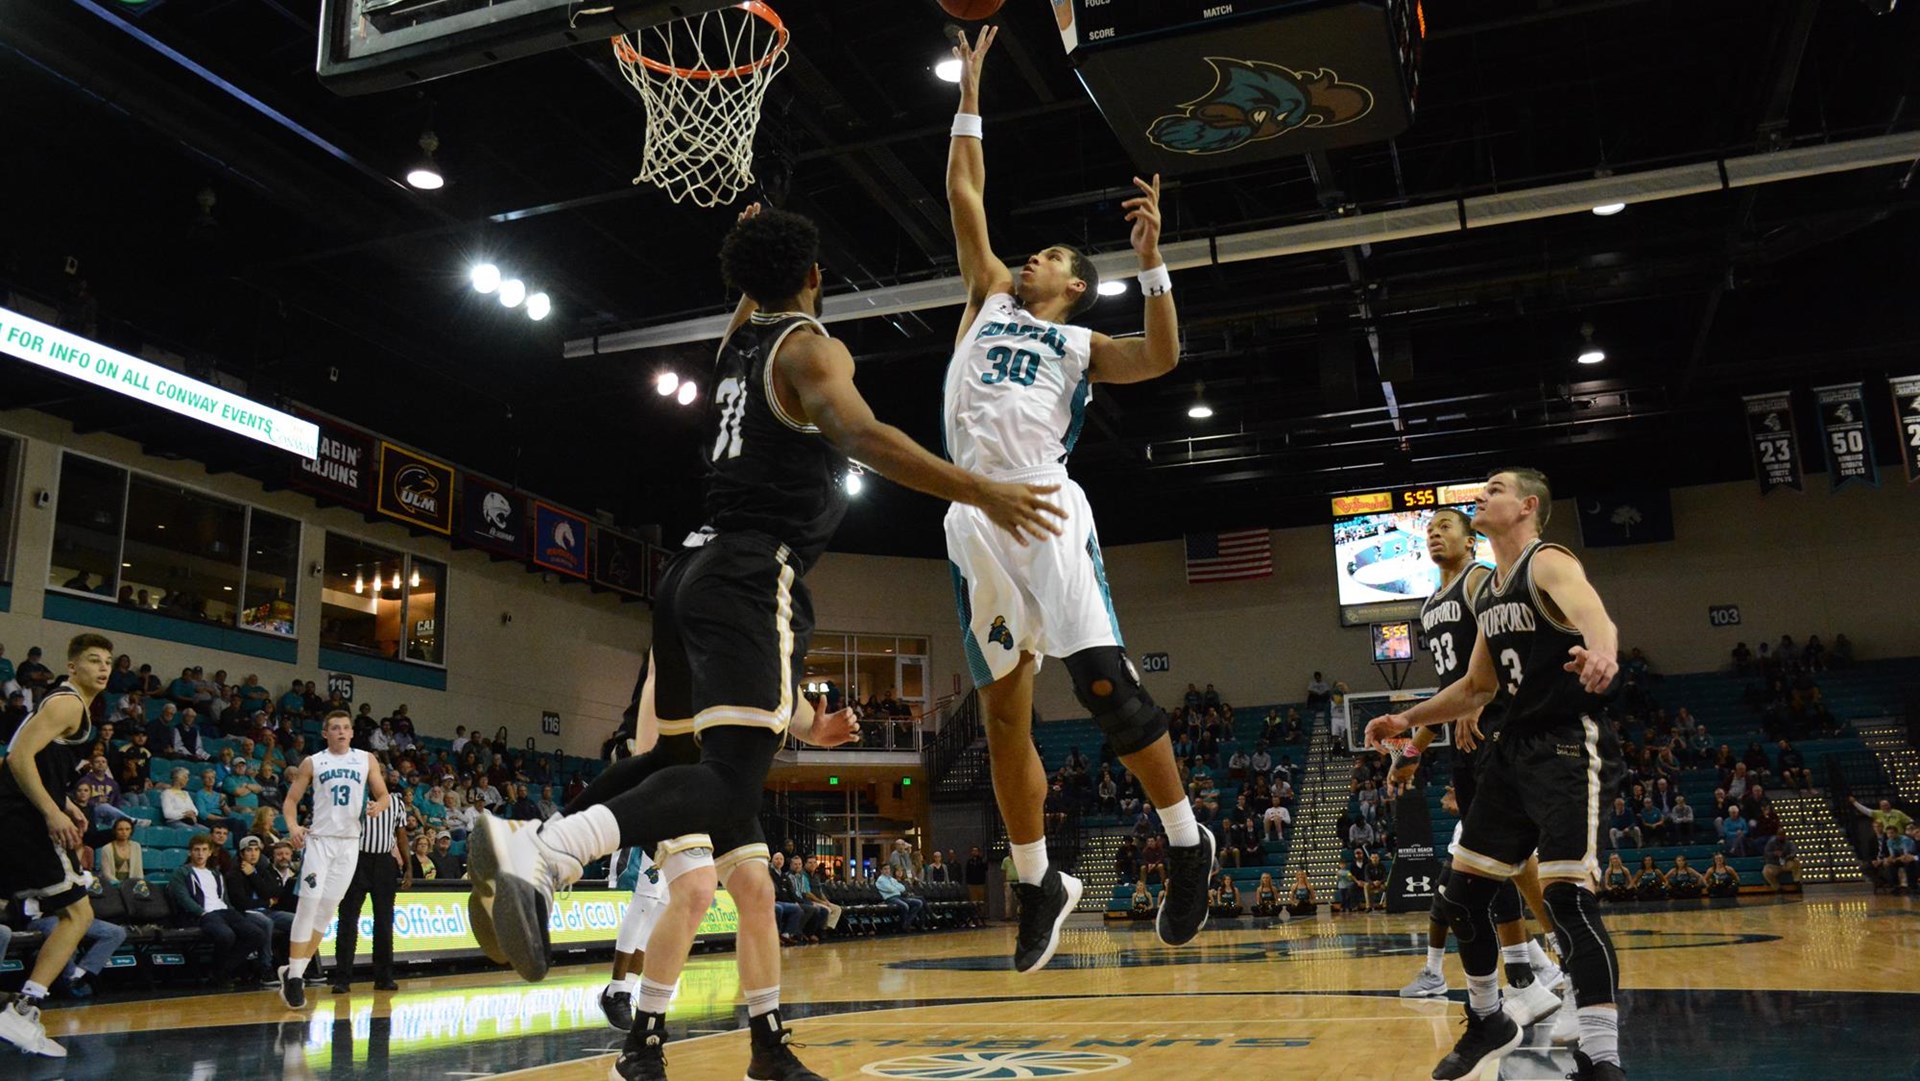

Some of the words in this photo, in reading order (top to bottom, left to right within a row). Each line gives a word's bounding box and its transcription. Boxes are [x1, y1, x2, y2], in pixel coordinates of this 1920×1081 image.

[1203, 5, 1233, 18] MATCH
[1089, 28, 1116, 40] SCORE
[981, 346, 1040, 386] 30
[7, 327, 45, 353] FOR
[49, 342, 91, 369] INFO
[95, 358, 119, 380] ON
[122, 369, 151, 391] ALL
[156, 380, 219, 414] CONWAY
[221, 404, 273, 434] EVENTS
[321, 436, 361, 466] AGIN'
[1760, 439, 1791, 463] 23
[1831, 430, 1863, 454] 50
[302, 458, 358, 488] CAJUNS
[401, 490, 435, 512] ULM
[1404, 490, 1434, 507] 5:55
[1711, 609, 1739, 624] 103
[1382, 624, 1409, 640] 5:55
[1430, 632, 1457, 676] 33
[1501, 648, 1523, 696] 3
[330, 679, 351, 699] 115
[544, 716, 559, 732] 116
[319, 768, 361, 784] COASTAL
[331, 785, 351, 806] 13
[394, 906, 464, 936] Official
[568, 906, 584, 926] of
[585, 903, 617, 928] CCU
